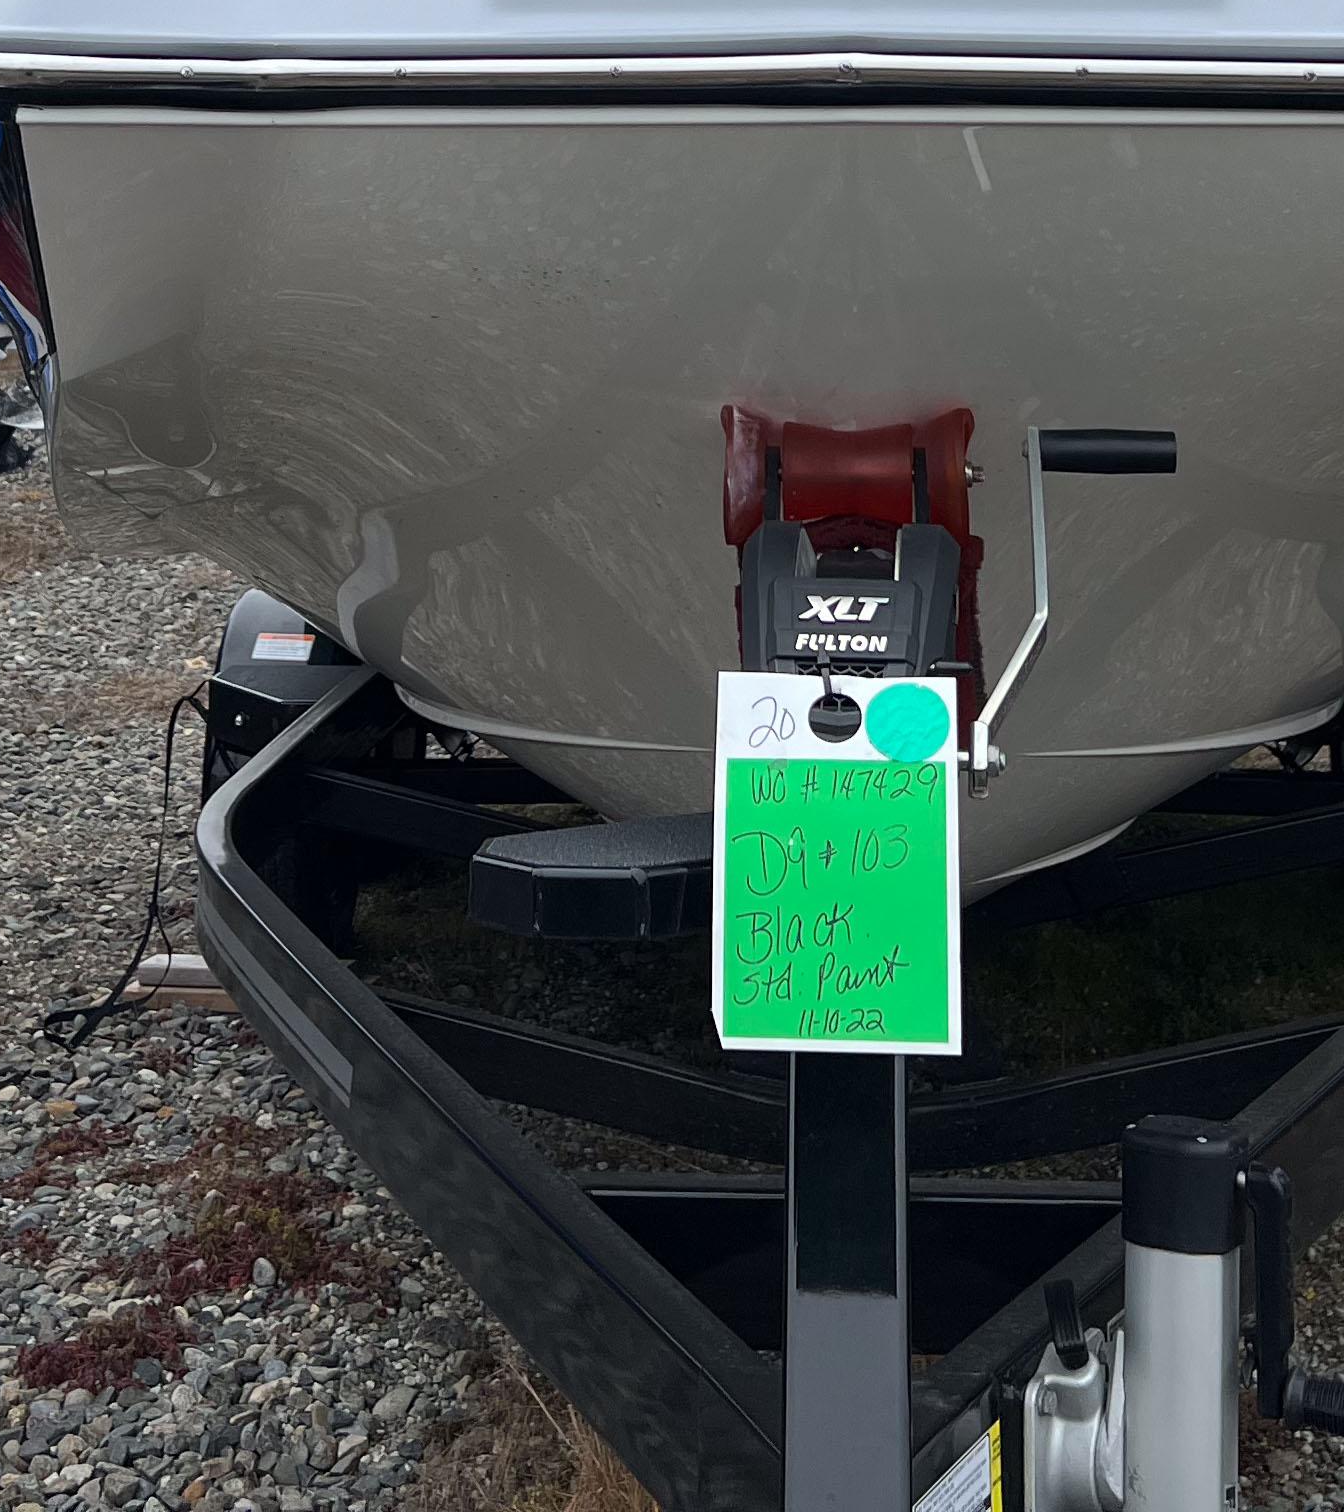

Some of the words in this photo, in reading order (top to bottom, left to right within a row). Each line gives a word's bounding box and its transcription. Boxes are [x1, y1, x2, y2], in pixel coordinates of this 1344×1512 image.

[798, 595, 890, 623] XLT
[795, 633, 888, 653] FULTON
[748, 696, 796, 748] 20
[851, 824, 909, 877] 103
